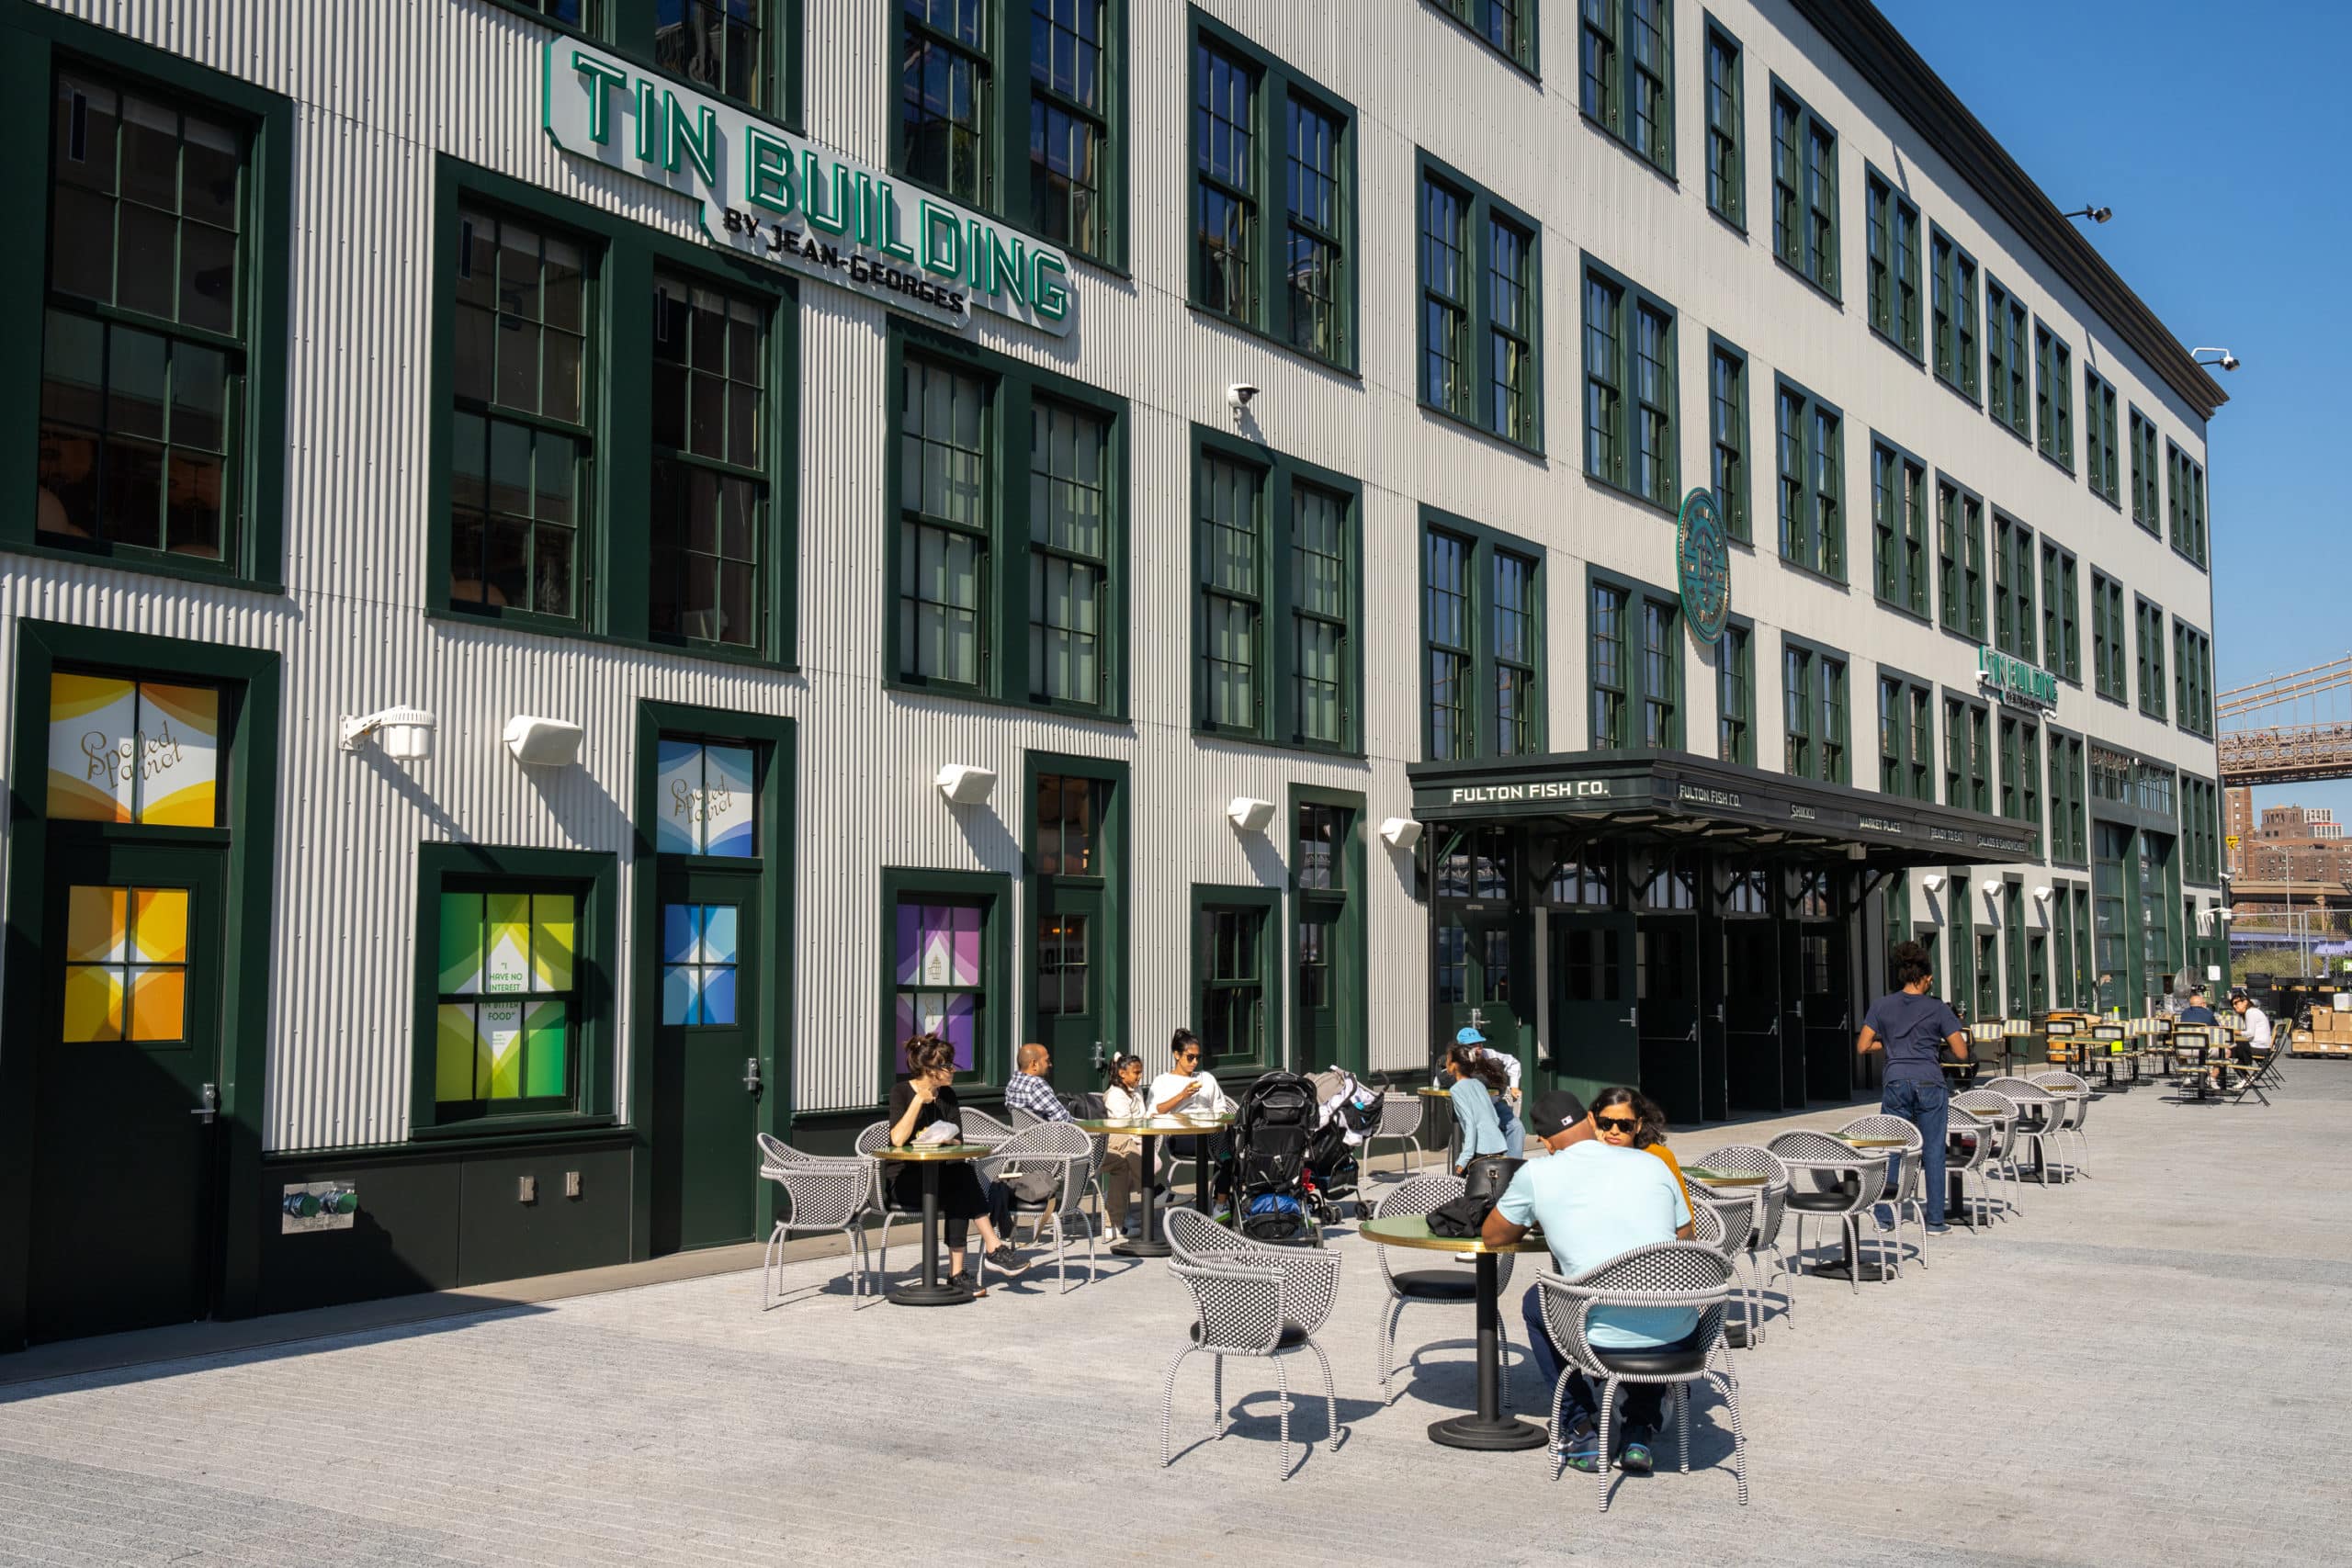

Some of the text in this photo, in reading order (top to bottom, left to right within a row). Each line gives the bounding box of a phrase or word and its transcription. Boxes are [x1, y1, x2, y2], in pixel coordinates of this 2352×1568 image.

[571, 50, 1067, 321] TIN BUILDING
[723, 207, 965, 314] BY JEAN-GEORGES
[81, 720, 171, 789] Spoled
[1453, 781, 1609, 803] FULTON FISH CO.
[1679, 784, 1742, 807] FULTON FISH CO.
[490, 973, 523, 981] HAVE NO
[490, 984, 521, 992] INTEREST
